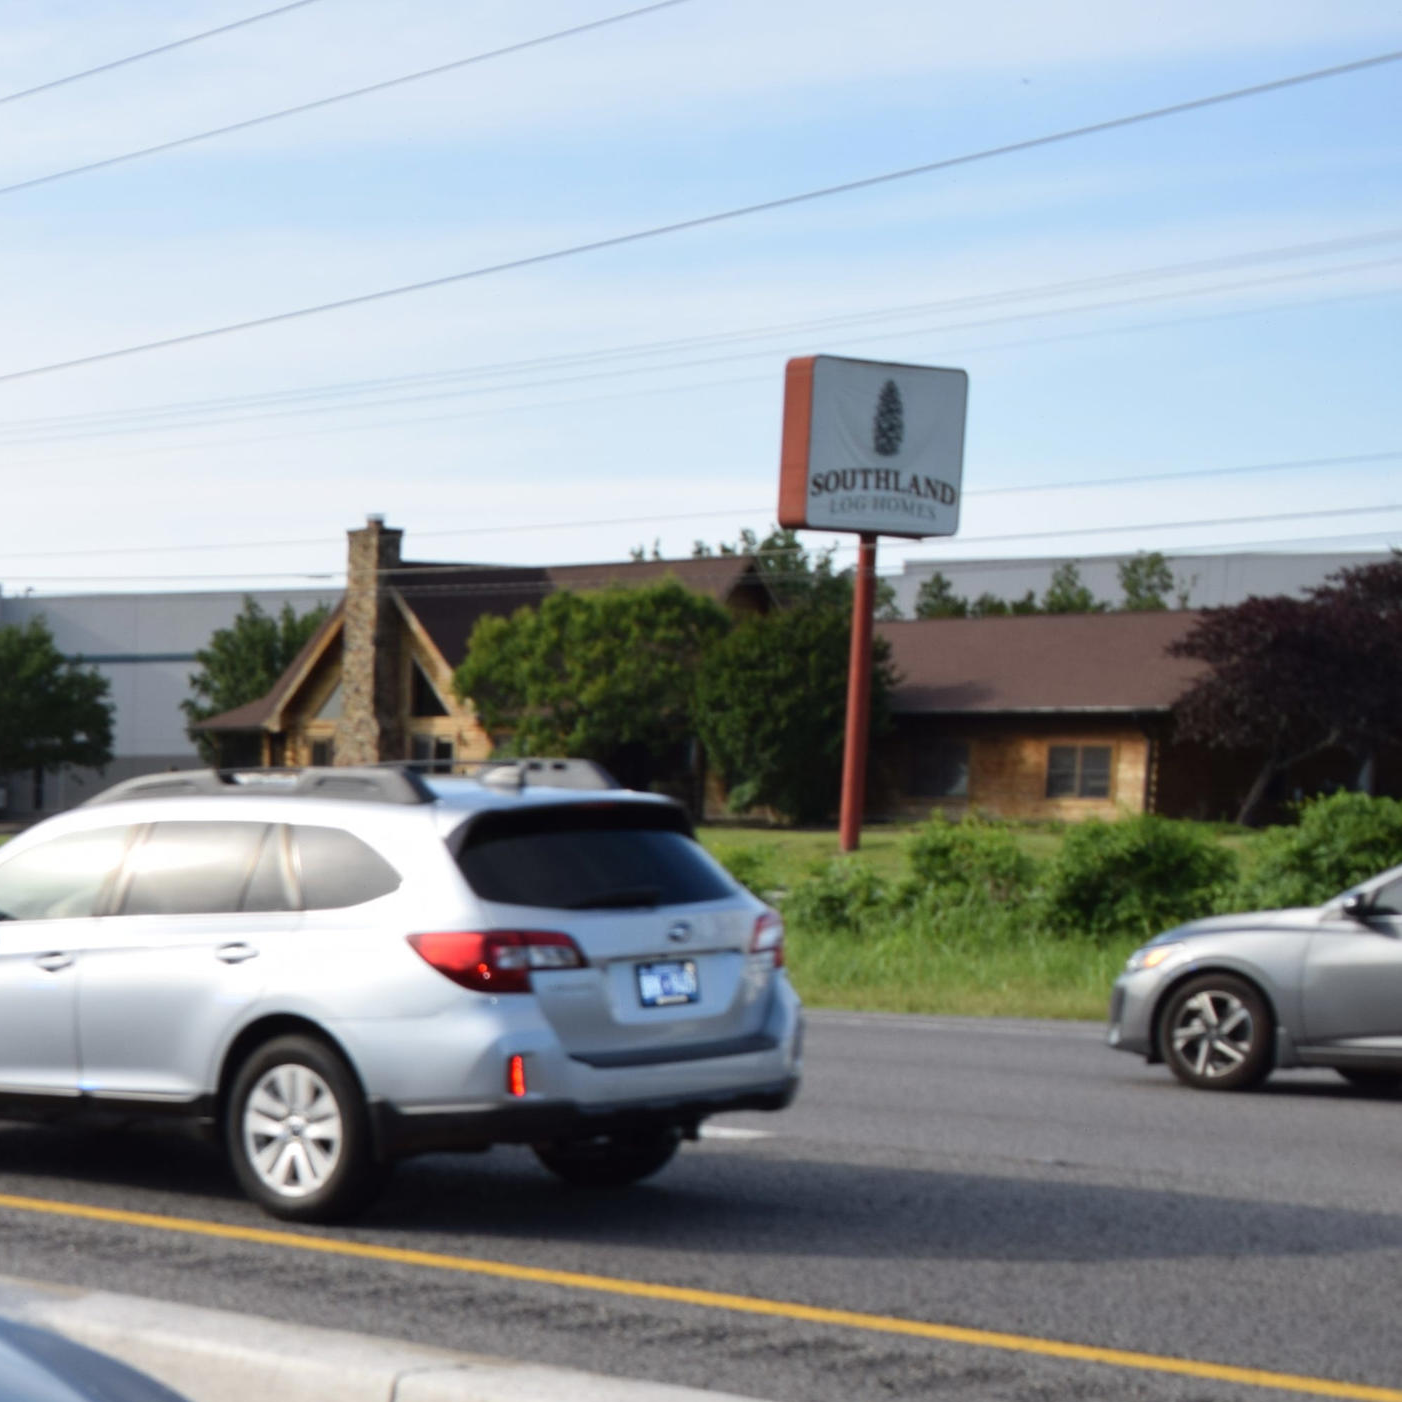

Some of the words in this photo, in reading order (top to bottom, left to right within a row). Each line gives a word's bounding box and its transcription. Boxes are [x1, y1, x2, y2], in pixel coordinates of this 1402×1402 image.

[810, 468, 957, 506] SOUTHLAND
[829, 495, 867, 516] LOG
[871, 499, 937, 521] HOMES
